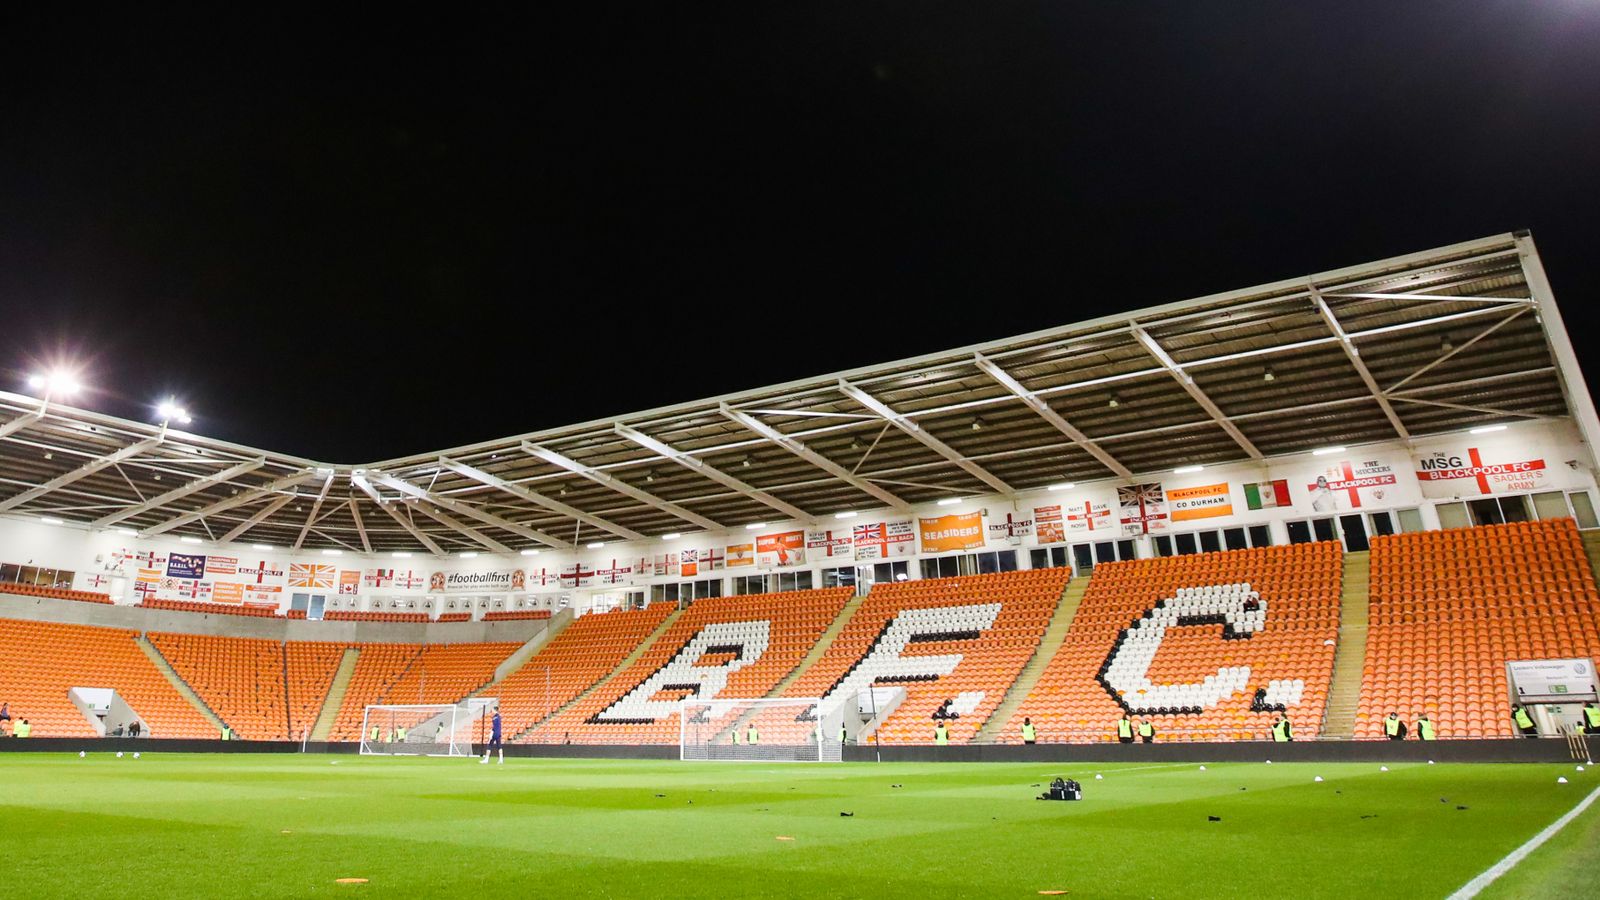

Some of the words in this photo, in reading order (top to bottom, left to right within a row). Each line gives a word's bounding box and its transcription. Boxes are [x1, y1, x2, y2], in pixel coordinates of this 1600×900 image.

[1363, 460, 1379, 468] THE
[1420, 456, 1463, 470] MSG
[1430, 465, 1510, 480] BLACKPOOL
[1513, 462, 1531, 472] FC
[1329, 478, 1379, 490] BLACKPOOL
[1381, 475, 1392, 483] FC
[1507, 481, 1536, 490] ARMY
[1173, 488, 1210, 498] BLACKPOOL
[1191, 497, 1225, 507] DURHAM
[1130, 515, 1158, 523] ENGLAND
[989, 521, 1022, 531] BLACKPOOL
[924, 526, 979, 540] SEASIDERS
[811, 539, 840, 547] BLACKPOOL
[855, 538, 885, 546] BLACKPOOL
[448, 571, 510, 583] #footballfirst
